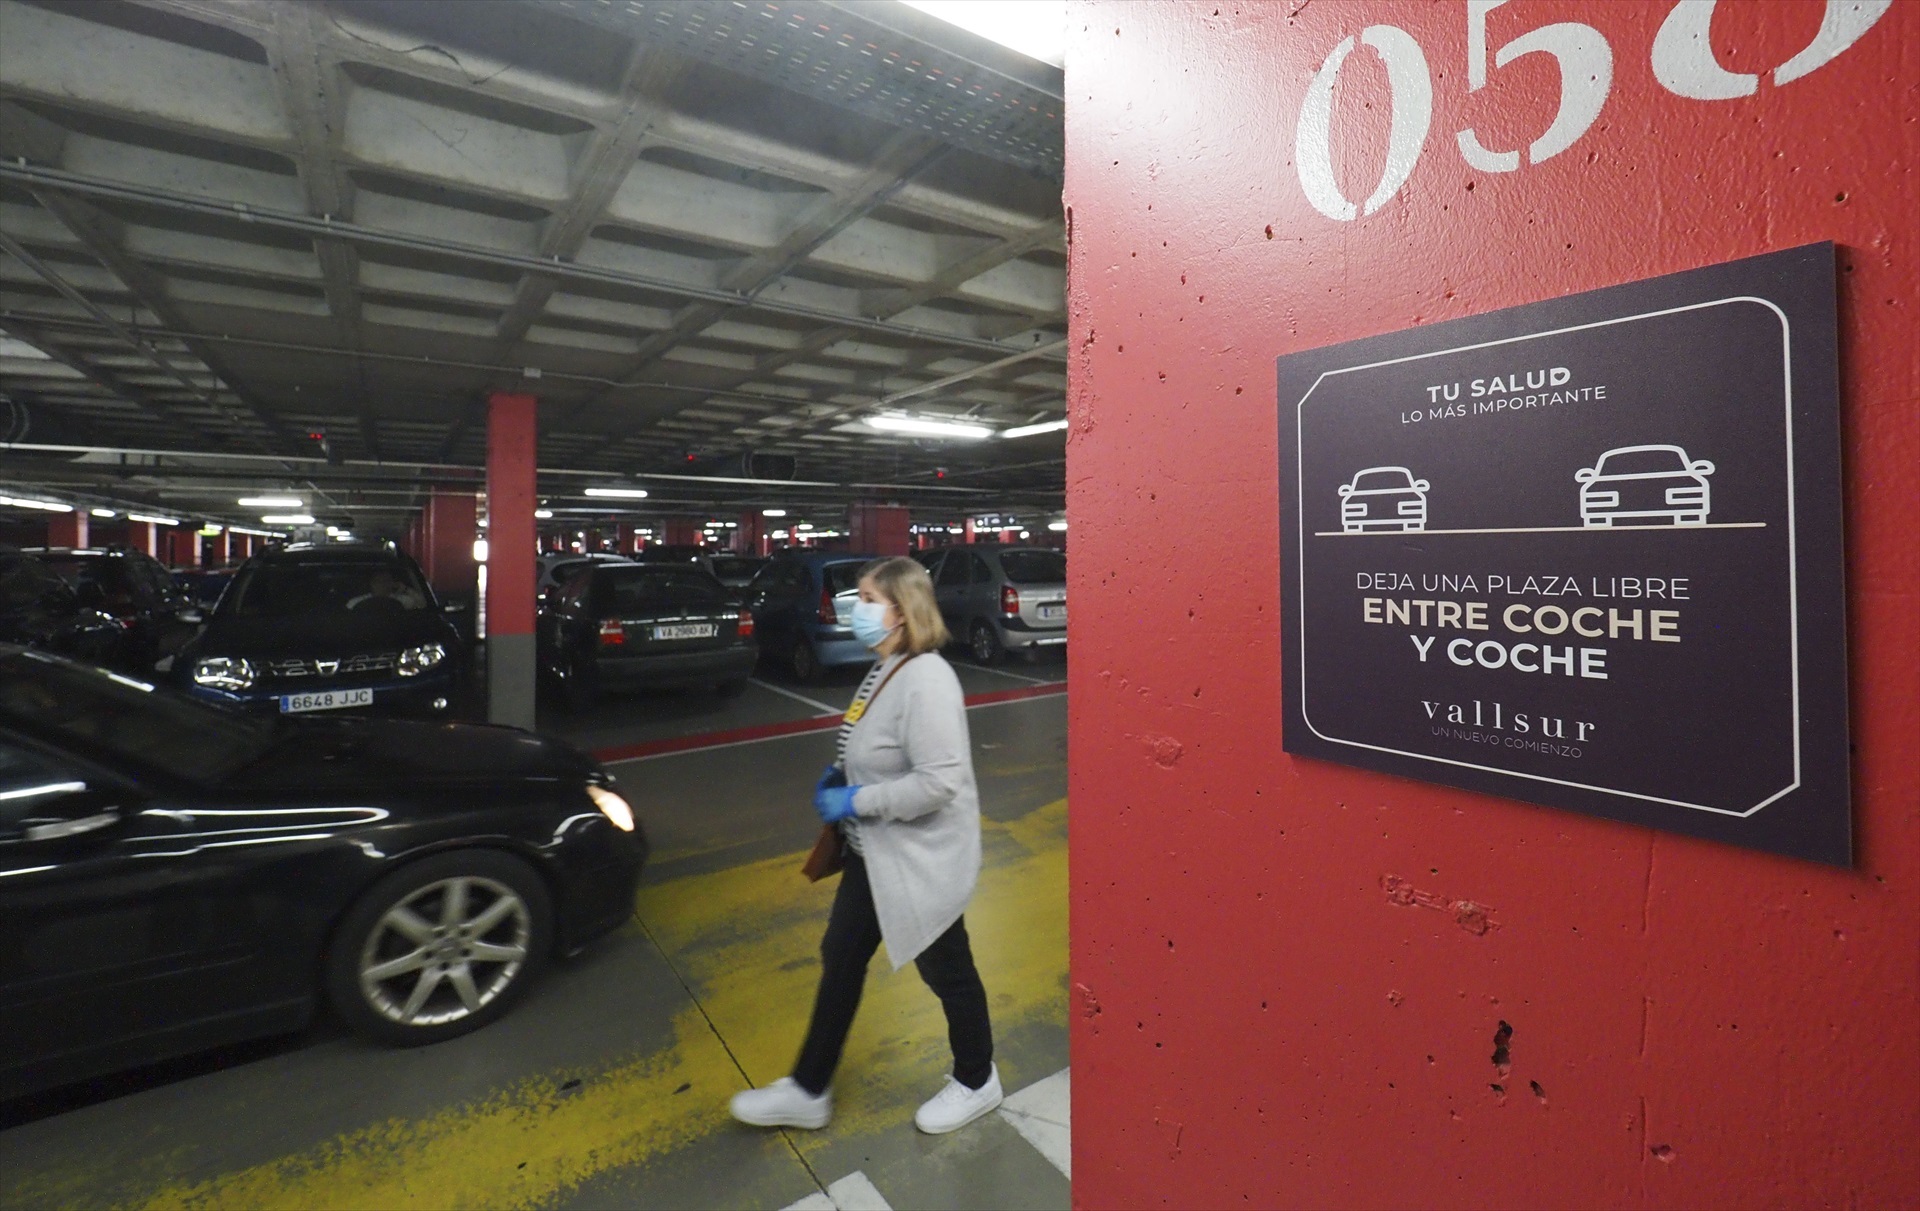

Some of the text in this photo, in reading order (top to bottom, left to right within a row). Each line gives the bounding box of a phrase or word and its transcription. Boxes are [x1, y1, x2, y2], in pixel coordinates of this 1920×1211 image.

[1426, 366, 1571, 403] TU SALUD
[1401, 385, 1607, 424] LO MÁS IMPORTANTE
[1356, 572, 1690, 600] DEJA UNA PLAZA LIBRE
[1363, 597, 1681, 643] ENTRE COCHE
[1410, 634, 1608, 680] Y COCHE
[292, 690, 369, 709] 6648 JJC
[1421, 699, 1596, 743] vallsur
[1431, 726, 1583, 759] UN NUEVO COMIENZO
